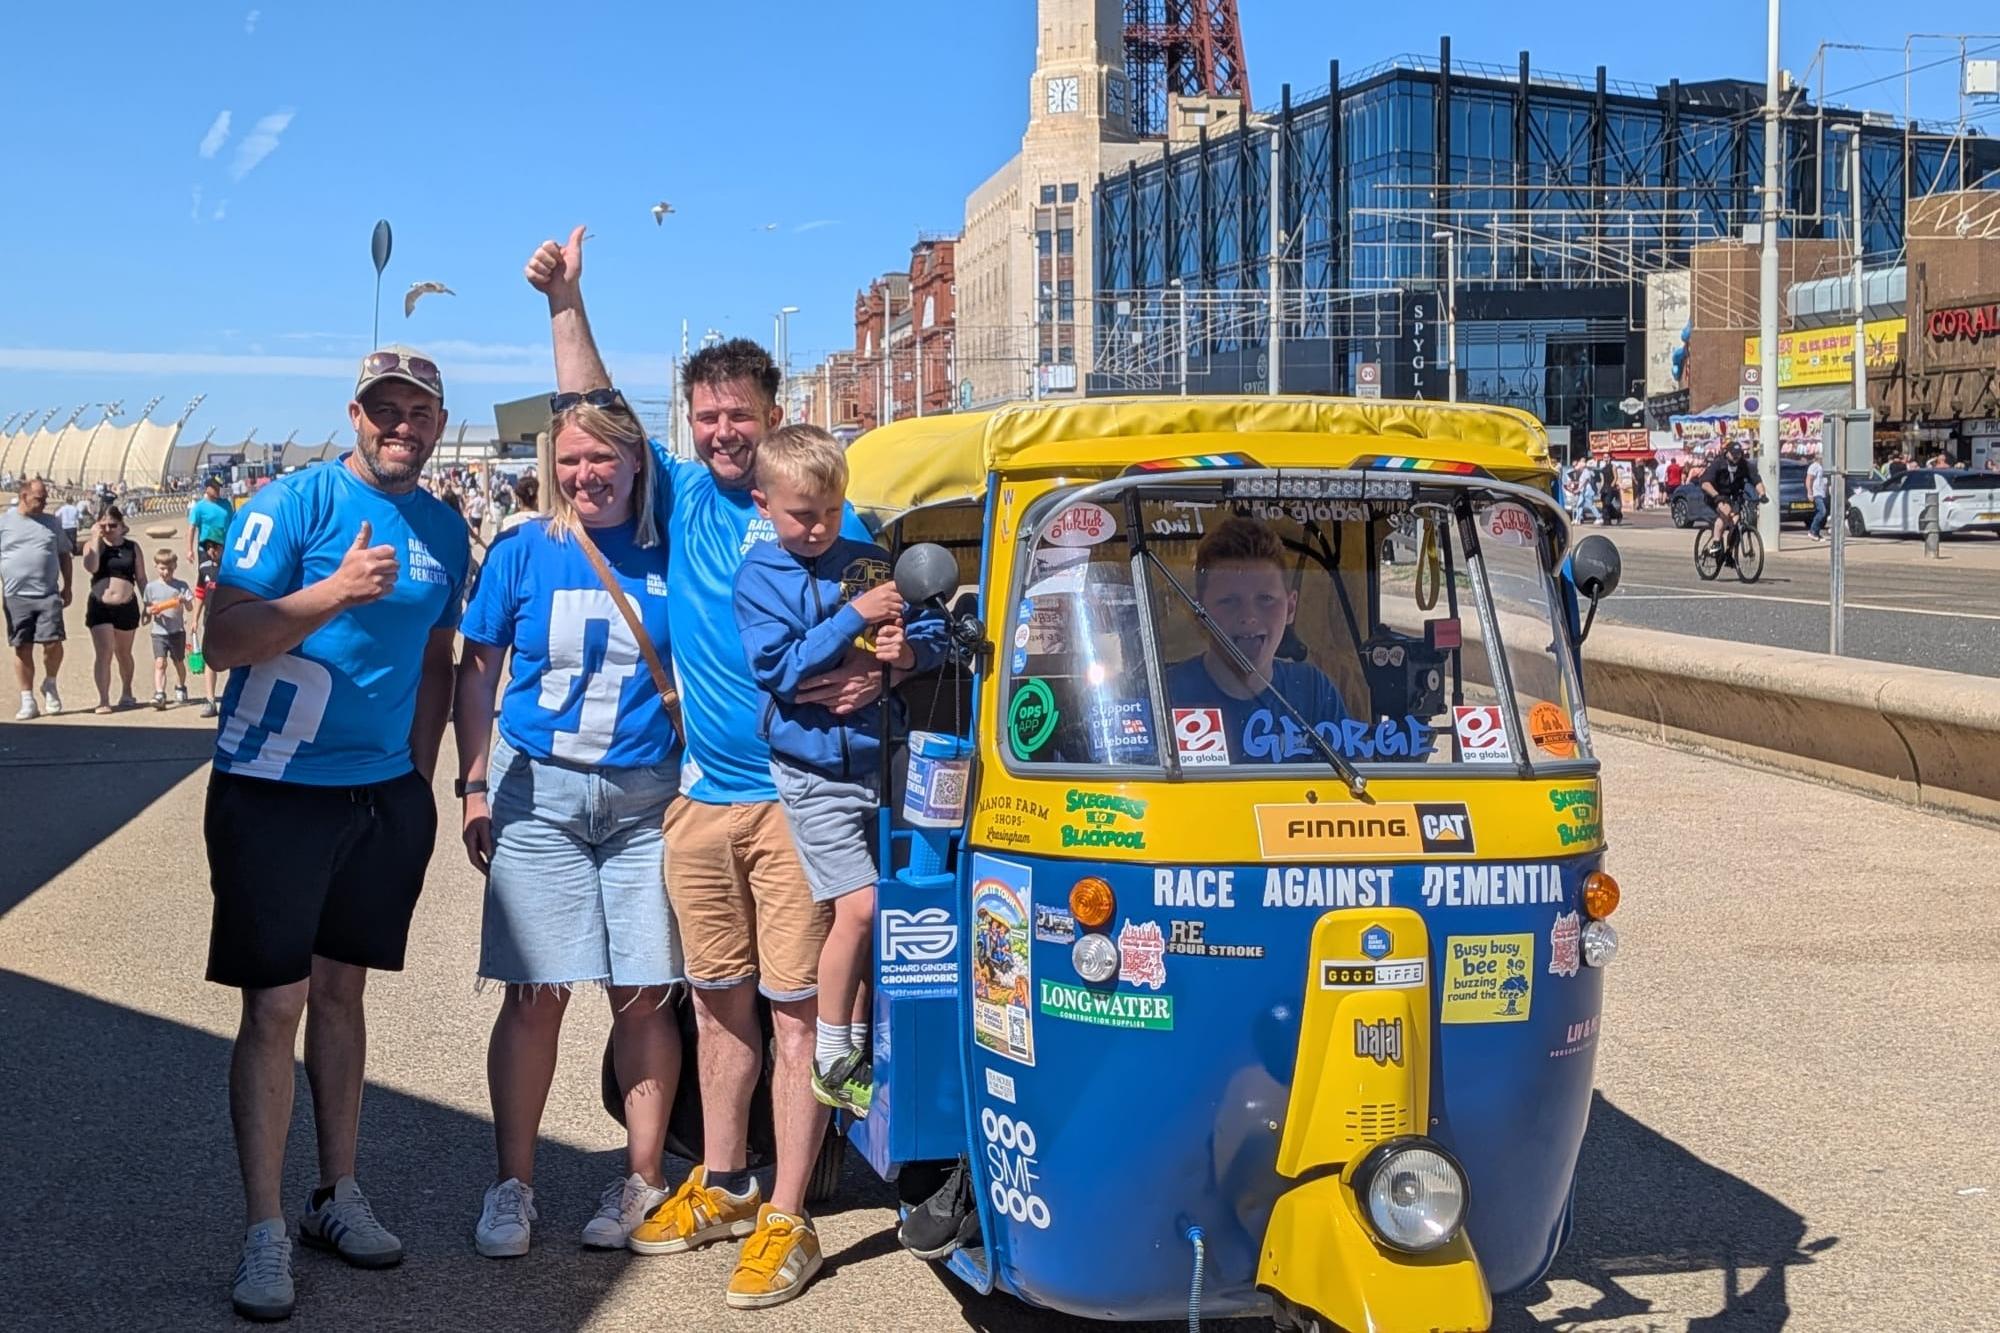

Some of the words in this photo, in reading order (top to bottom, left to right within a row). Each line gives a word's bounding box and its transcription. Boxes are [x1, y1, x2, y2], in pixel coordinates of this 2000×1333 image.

[1291, 501, 1370, 524] global
[1020, 705, 1042, 719] OPS
[1092, 702, 1142, 717] Support
[1019, 719, 1039, 732] APP
[1243, 709, 1439, 763] GEORGE
[1181, 755, 1193, 763] go
[1196, 753, 1226, 763] global
[1464, 752, 1476, 760] go
[1479, 750, 1508, 761] global
[1015, 798, 1050, 820] FARM
[1066, 789, 1148, 819] SKEGNESS
[995, 814, 1022, 826] SHOPS
[1093, 812, 1108, 823] to
[1061, 825, 1146, 849] BLACKPOOL
[1423, 815, 1465, 841] CAT
[1154, 869, 1235, 907] RACE
[1263, 868, 1394, 907] AGAINST
[1422, 865, 1563, 906] DEMENTIA
[1170, 920, 1204, 943] RE
[1167, 943, 1205, 955] FOUR
[1209, 945, 1264, 957] STROKE
[1453, 943, 1488, 959] Busy
[1490, 940, 1520, 957] busy
[881, 963, 920, 974] RICHARD
[921, 962, 958, 972] GINDERS
[1463, 958, 1498, 977] bee
[881, 973, 958, 984] GROUNDWORKS
[1454, 976, 1497, 990] buzzing
[1041, 983, 1170, 1019] LONGWATER
[1447, 990, 1478, 1002] round
[1480, 989, 1497, 1000] the
[1499, 989, 1519, 1000] tree
[1060, 1010, 1109, 1025] CONSTRUCTION
[1113, 1017, 1145, 1028] SUPPLIES
[1355, 1018, 1403, 1066] bajaj
[988, 1143, 1040, 1193] SMF
